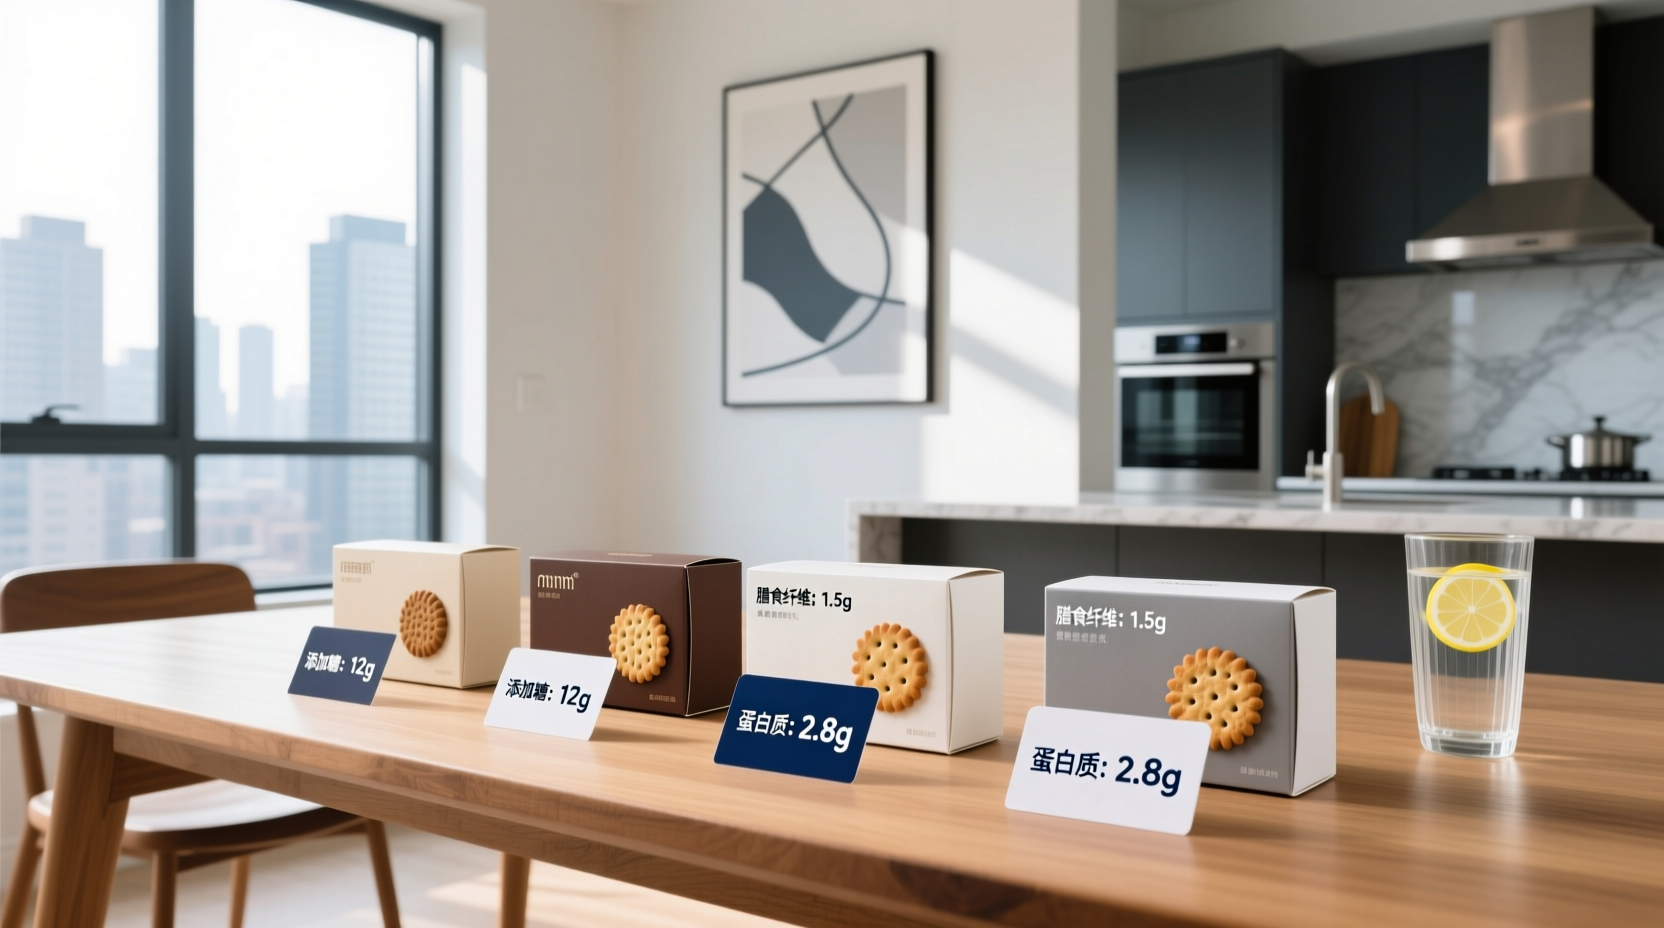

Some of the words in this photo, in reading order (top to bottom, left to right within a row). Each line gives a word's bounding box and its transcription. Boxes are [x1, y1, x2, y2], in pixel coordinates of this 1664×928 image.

[821, 592, 852, 612] 1.5g
[1130, 611, 1166, 635] 1.5g
[350, 656, 376, 682] 12g
[560, 684, 592, 714] 12g
[798, 714, 854, 753] 2.8g
[1115, 755, 1182, 798] 2.8g
